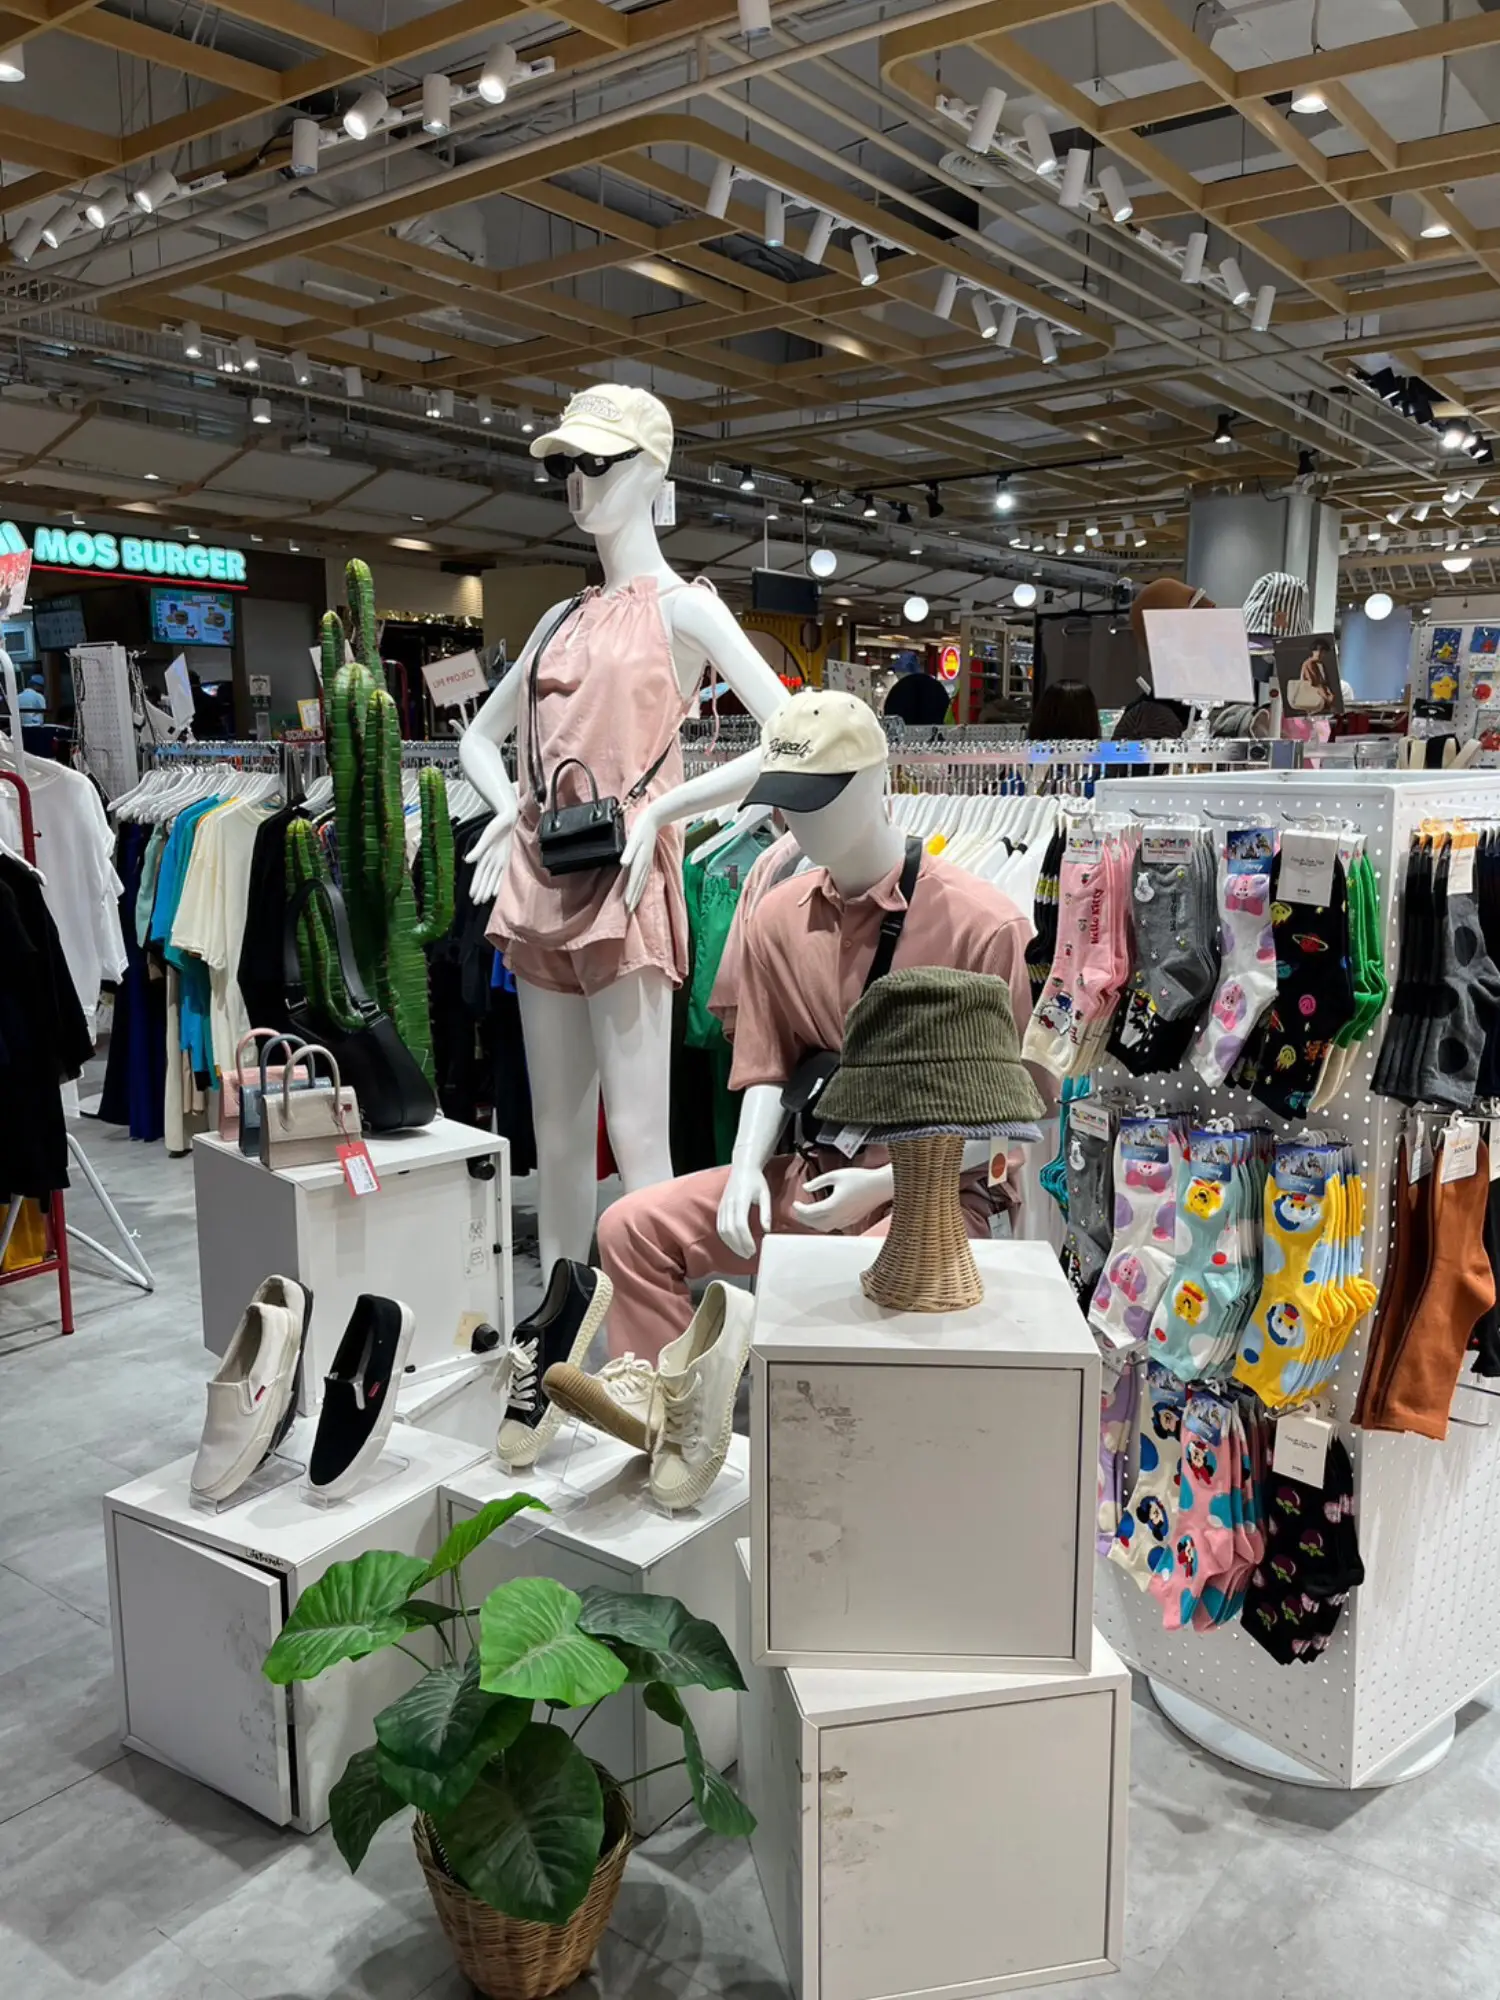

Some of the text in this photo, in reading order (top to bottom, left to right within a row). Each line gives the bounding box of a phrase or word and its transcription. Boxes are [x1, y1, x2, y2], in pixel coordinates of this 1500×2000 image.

[33, 526, 247, 582] MOS BURGER
[1088, 887, 1105, 945] Hello Kitty
